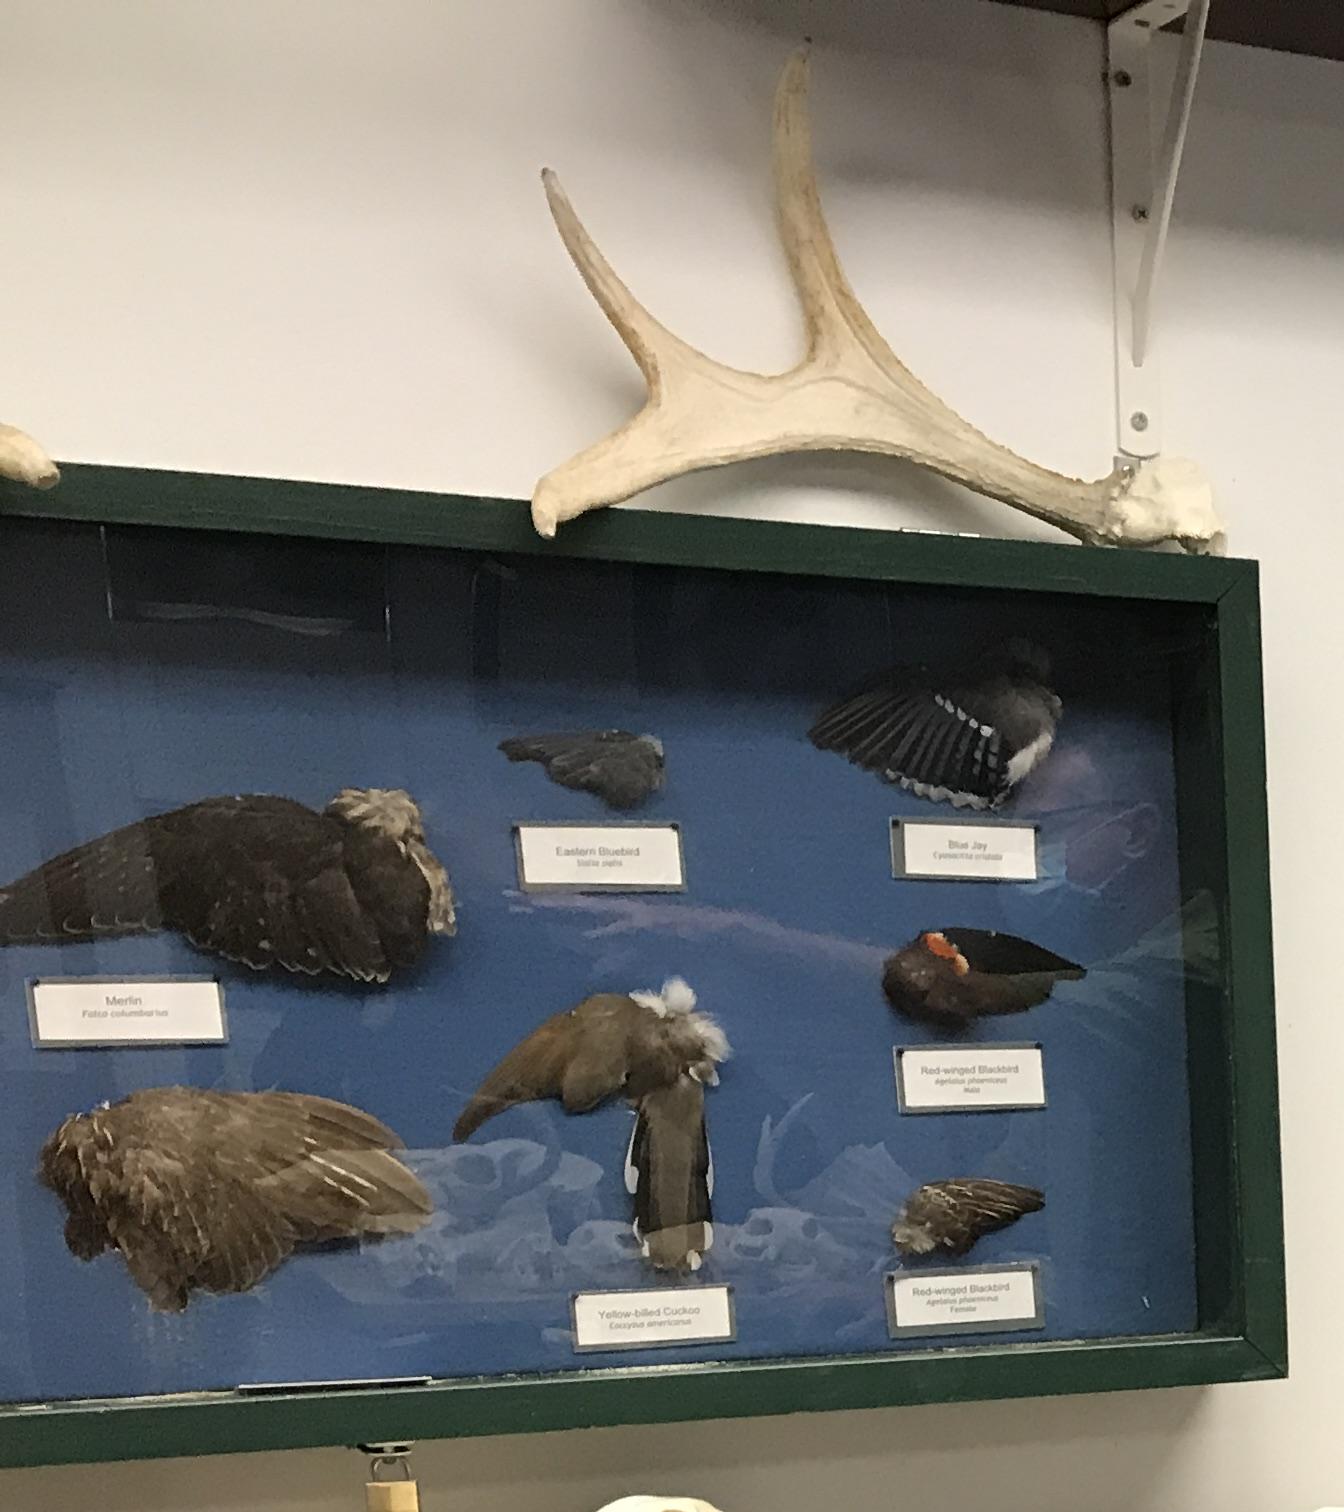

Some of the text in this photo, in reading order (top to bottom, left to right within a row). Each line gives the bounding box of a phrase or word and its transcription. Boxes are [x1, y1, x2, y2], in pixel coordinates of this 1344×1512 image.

[556, 847, 640, 857] Eastern Bluebird
[105, 996, 143, 1006] Merlin
[912, 1283, 1010, 1297] Red-winged Blackbird
[598, 1306, 701, 1319] Yellow-billed Cuckoo
